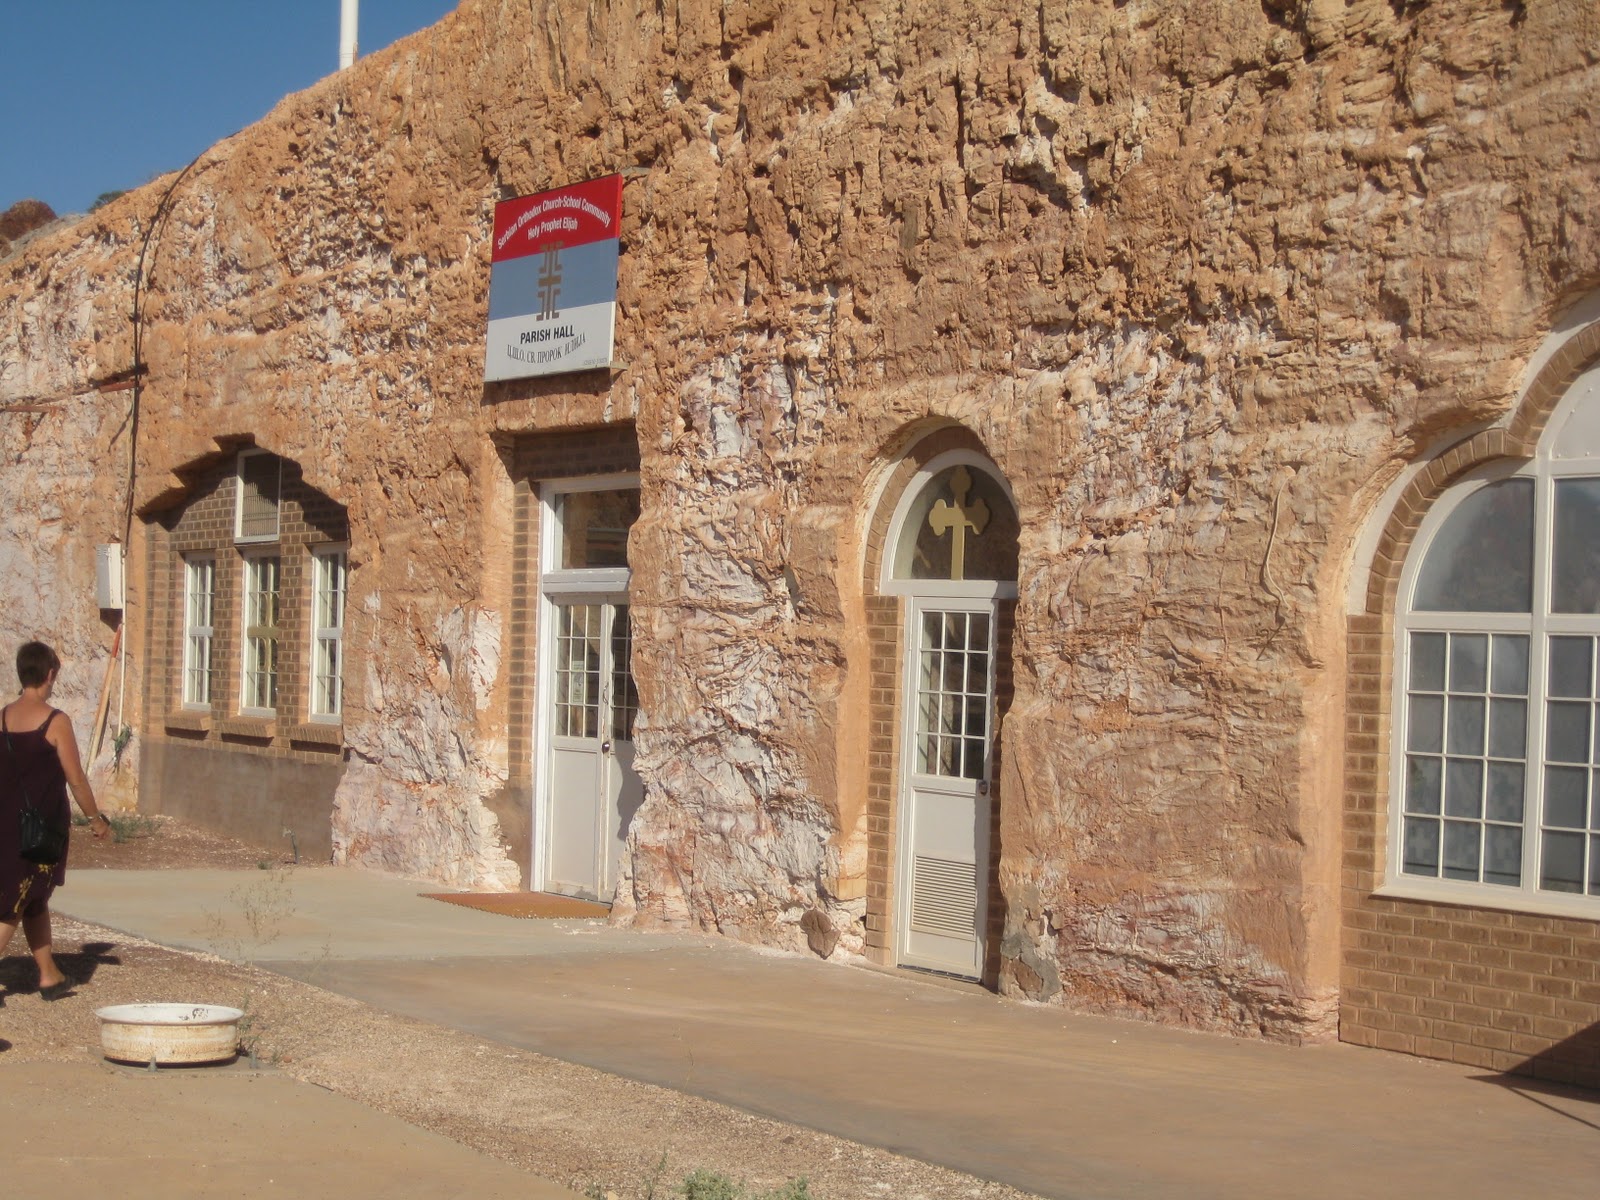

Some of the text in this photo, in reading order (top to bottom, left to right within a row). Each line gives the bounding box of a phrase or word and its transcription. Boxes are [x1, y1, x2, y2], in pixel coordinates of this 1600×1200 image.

[498, 223, 517, 249] Serbian
[518, 205, 541, 227] Orthodox
[582, 198, 611, 228] Community
[527, 217, 578, 240] Holy Prophet Elijah
[520, 324, 575, 345] PARISH HALL
